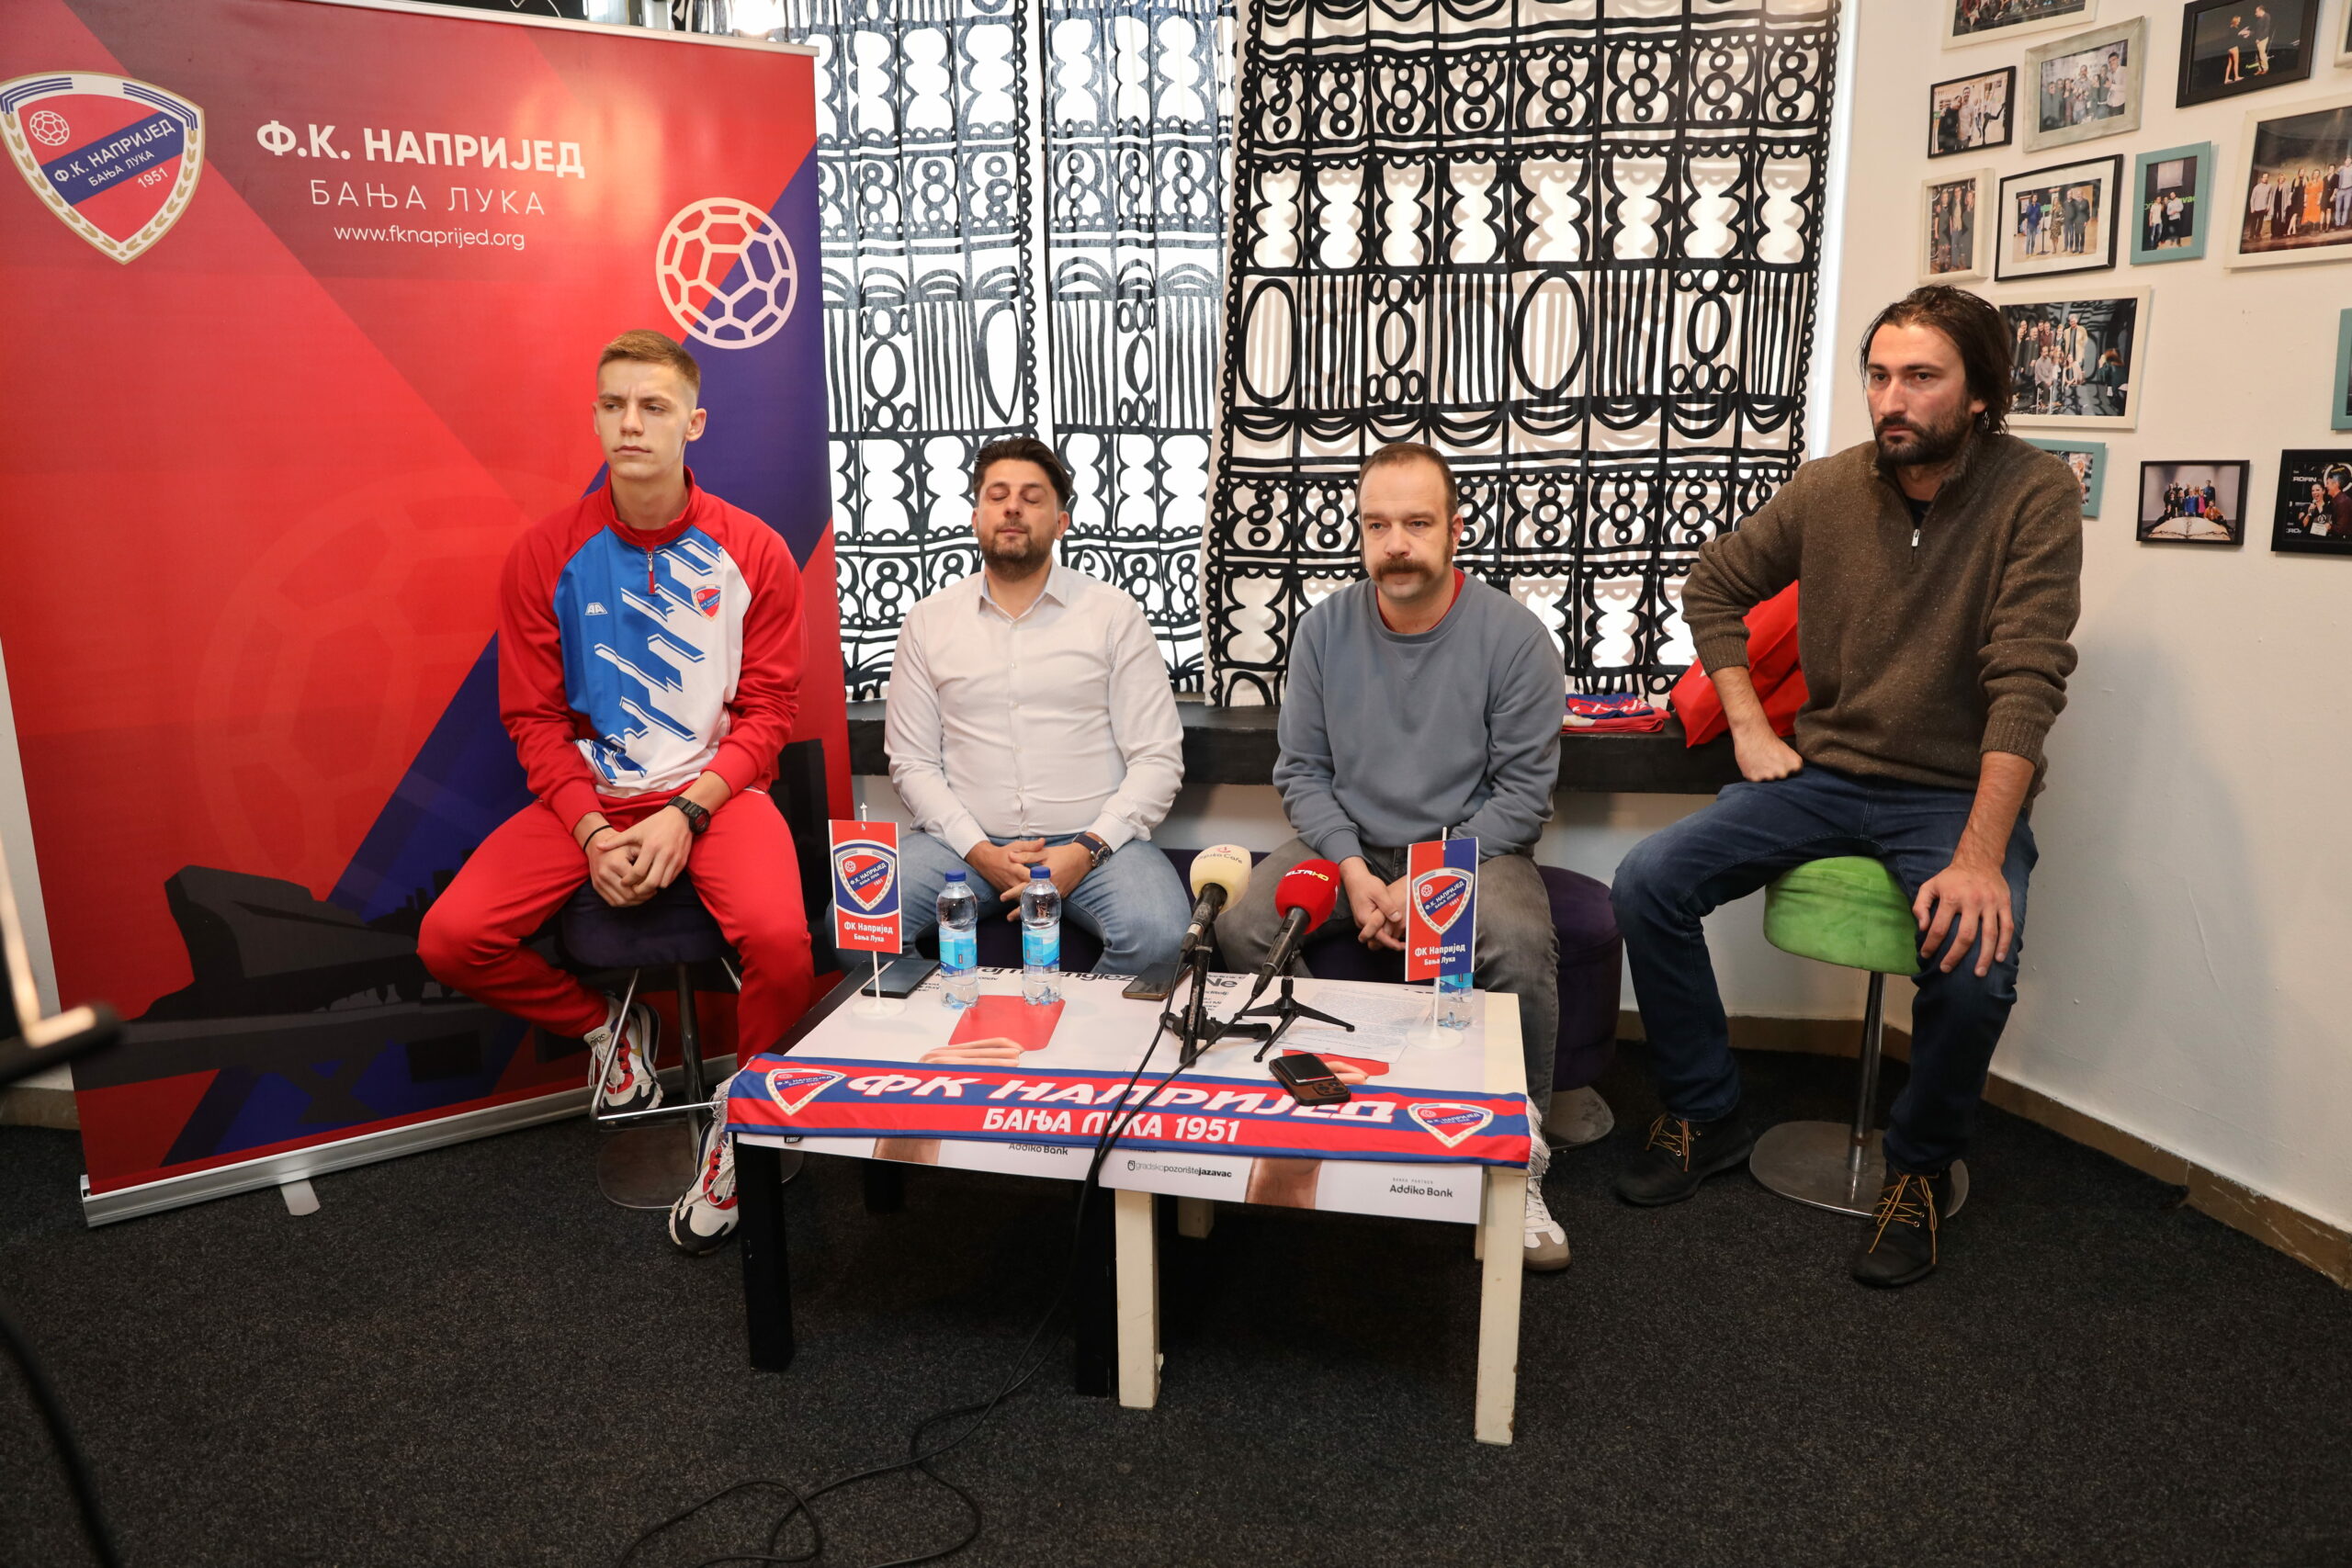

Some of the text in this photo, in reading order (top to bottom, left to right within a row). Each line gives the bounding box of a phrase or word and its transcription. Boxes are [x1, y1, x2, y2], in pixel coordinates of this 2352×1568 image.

[53, 118, 176, 182] Ф.К. НАПРИЈЕД
[256, 120, 585, 179] Ф.К. НАПРИЈЕД
[87, 150, 155, 187] БАЊА ЛУКА
[138, 166, 169, 188] 1951
[310, 179, 545, 215] БАЊА ЛУКА
[334, 225, 526, 251] www.fknaprijed.org
[860, 862, 887, 879] НАПРИЈЕД
[1435, 880, 1465, 903] НАПРИЈЕД
[843, 921, 894, 934] ФК Напријед
[870, 934, 885, 942] Лука
[1414, 942, 1466, 957] ФК Напријед
[847, 1074, 983, 1098] ФК
[982, 1108, 1240, 1143] БАЊА ЛУКА 1951
[1044, 1145, 1069, 1156] Bank
[1389, 1184, 1453, 1198] Addiko Bank
